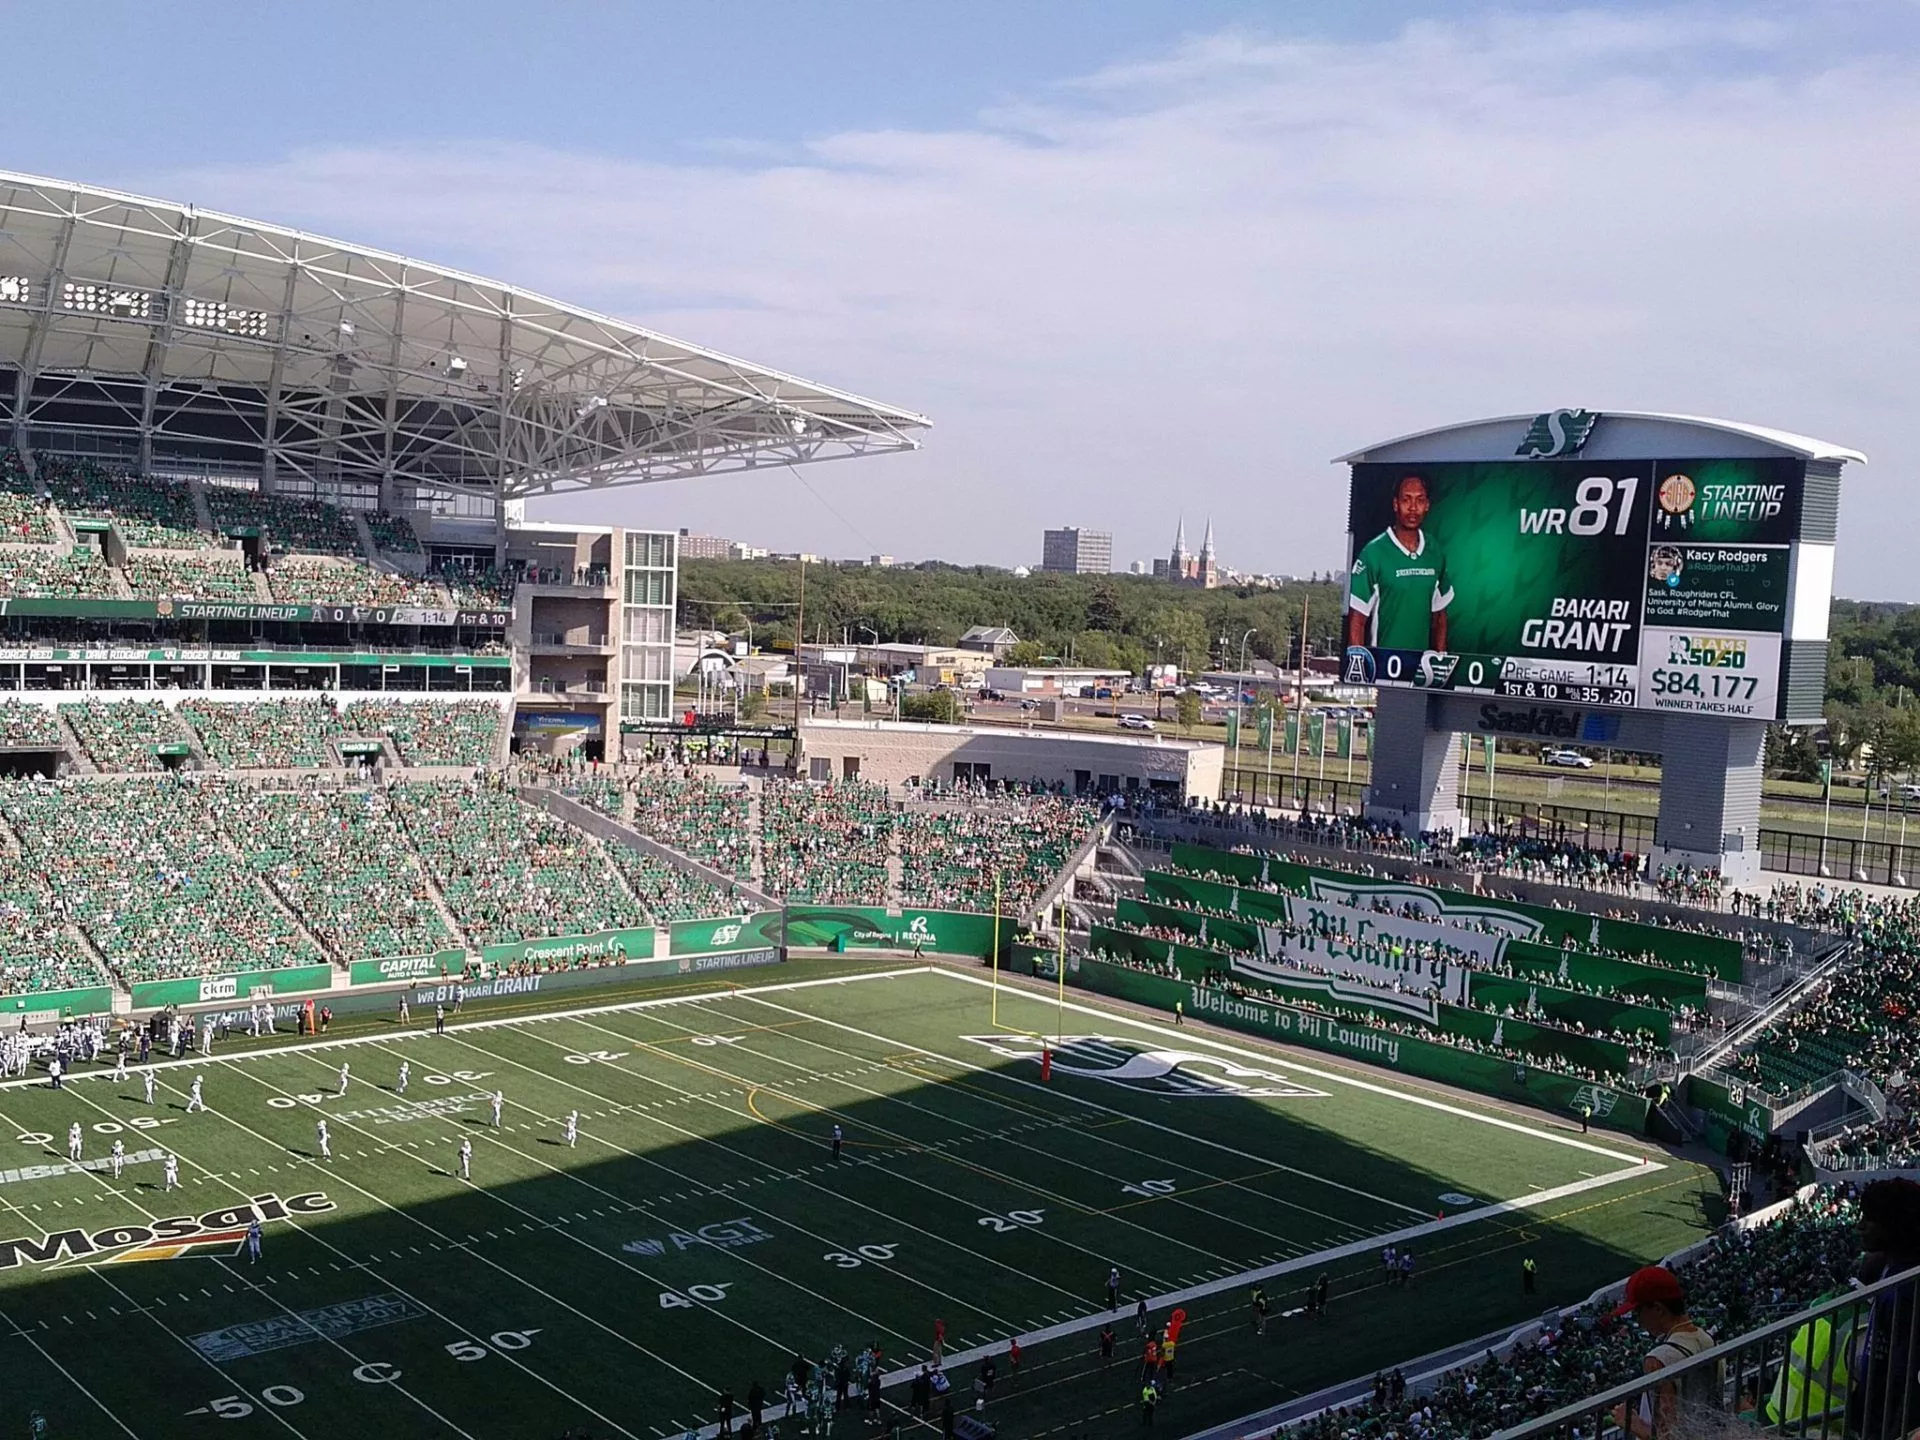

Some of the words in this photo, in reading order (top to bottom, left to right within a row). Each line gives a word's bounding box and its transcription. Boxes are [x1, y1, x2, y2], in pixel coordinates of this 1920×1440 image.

[1702, 485, 1785, 501] STARTING
[1520, 508, 1566, 534] WR
[1568, 477, 1639, 536] 81
[1701, 502, 1781, 521] LINEUP
[1686, 550, 1715, 564] Kacy
[1718, 550, 1768, 564] Rodgers
[1648, 588, 1668, 597] Sask.
[1670, 589, 1718, 600] Roughriders
[1720, 591, 1738, 600] CFL.
[181, 603, 246, 618] STARTING
[249, 605, 298, 620] LINEUP
[334, 608, 344, 621] 0
[1551, 598, 1630, 621] BAKARI
[1646, 606, 1656, 615] to
[1677, 608, 1730, 618] #RodgerThat
[1647, 598, 1686, 608] University
[1688, 599, 1697, 607] of
[1698, 600, 1722, 608] Miami
[1756, 602, 1780, 612] Glory
[376, 610, 386, 622] 0
[421, 611, 447, 624] 1:14
[492, 613, 506, 626] 10
[1521, 618, 1632, 653] GRANT
[1692, 638, 1746, 651] RAMS
[29, 650, 53, 660] REED
[85, 650, 108, 660] DAVE
[163, 650, 176, 660] 44
[180, 650, 208, 660] ROGER
[1387, 655, 1402, 678] 0
[1468, 661, 1484, 685] 0
[1586, 665, 1629, 688] 1:14
[1651, 668, 1759, 700] $84,177
[1525, 682, 1537, 697] &
[1542, 684, 1558, 699] 10
[1582, 687, 1600, 702] 35
[1655, 698, 1693, 710] WINNER
[1695, 701, 1726, 713] TAKES
[1728, 704, 1754, 715] HALF
[1478, 703, 1581, 738] SaskTel
[902, 931, 937, 941] REGINA
[524, 945, 574, 960] Crescent
[576, 941, 604, 956] Point
[380, 956, 437, 973] CAPITAL
[696, 957, 741, 971] STARTING
[742, 951, 775, 965] LINEUP
[387, 970, 405, 978] AUTO
[203, 983, 236, 996] ckrm
[417, 991, 434, 1004] WR
[436, 985, 455, 1002] 81
[456, 985, 492, 1000] AKARI
[493, 974, 543, 996] GRANT
[1191, 985, 1270, 1025] Welcome
[1274, 1010, 1291, 1030] to
[1297, 1011, 1321, 1038] Pil
[1327, 1019, 1401, 1063] Country
[1121, 1178, 1176, 1198] 10
[978, 1209, 1045, 1233] 20
[0, 1192, 338, 1271] Mosaic
[668, 1216, 764, 1251] AGT
[823, 1243, 895, 1269] 30
[659, 1284, 727, 1309] 40
[231, 1297, 402, 1339] INAUGURAL
[244, 1317, 354, 1348] SEASON
[444, 1331, 533, 1362] 50
[209, 1384, 305, 1420] 50
